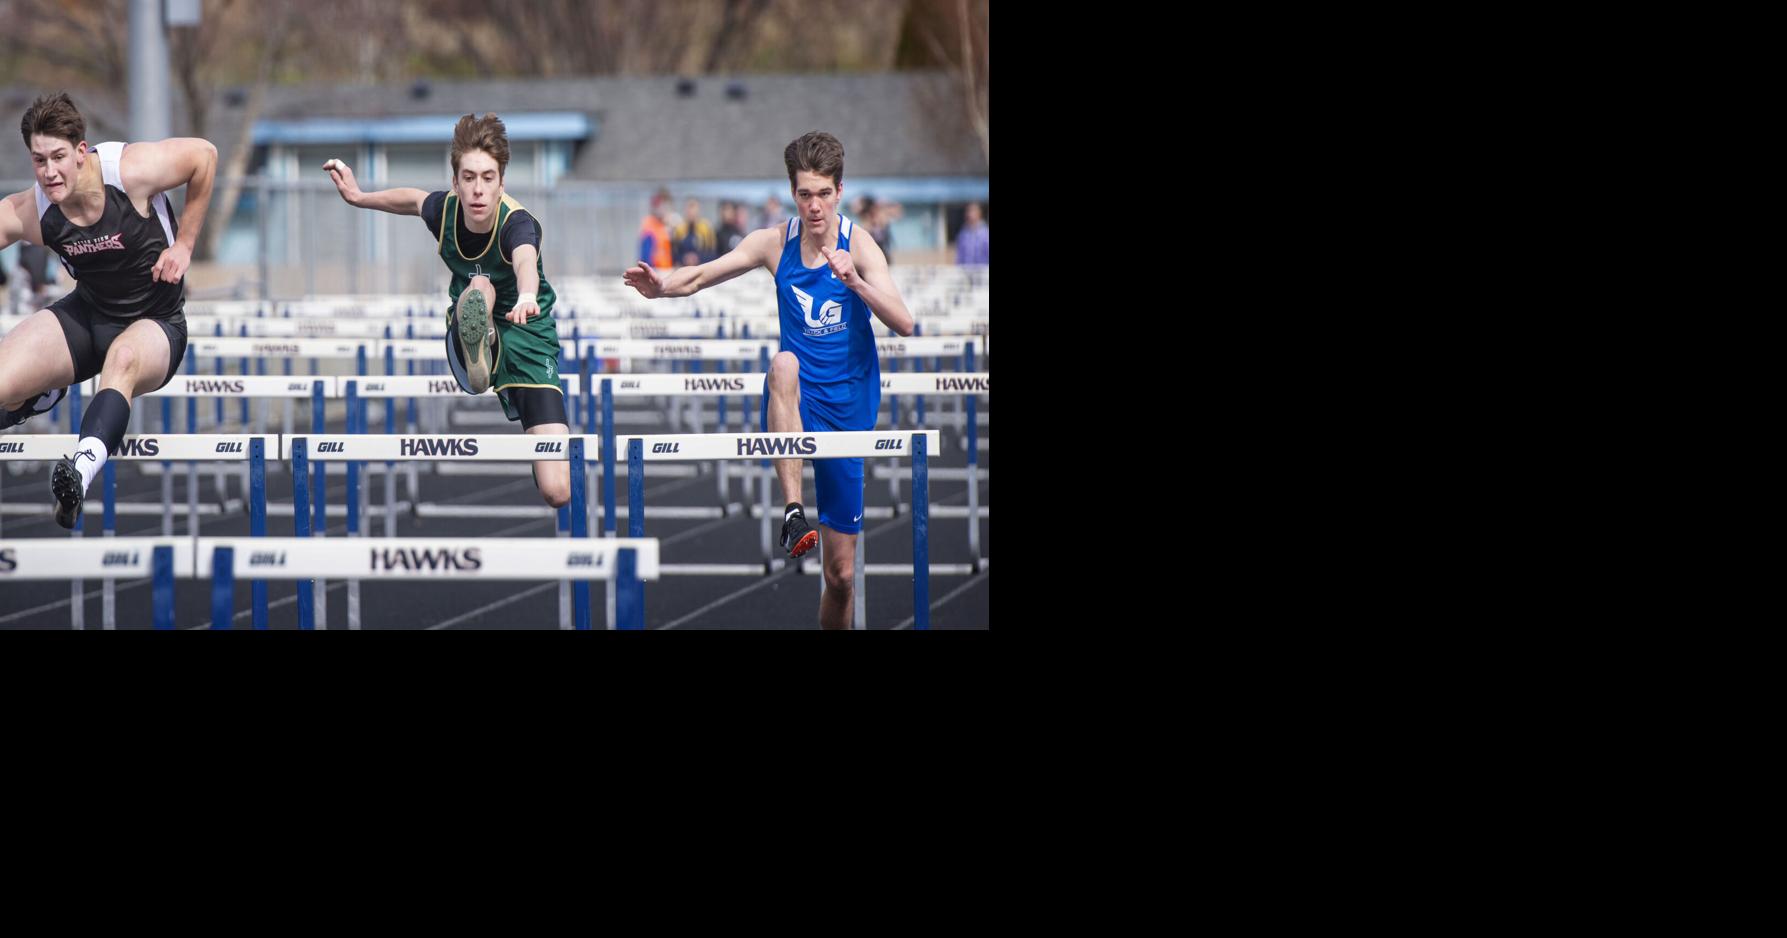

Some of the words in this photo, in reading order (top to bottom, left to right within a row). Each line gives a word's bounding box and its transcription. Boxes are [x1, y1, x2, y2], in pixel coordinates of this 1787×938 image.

[62, 232, 125, 256] PANTHERS
[186, 380, 244, 393] HAWKS
[429, 380, 464, 393] HAW
[685, 378, 744, 391] HAWKS
[0, 442, 24, 453] GILL
[110, 438, 160, 456] WKS
[215, 442, 243, 453] GILL
[317, 442, 344, 453] GILL
[400, 438, 479, 456] HAWKS
[534, 441, 562, 453] GILL
[652, 442, 680, 453] GILL
[737, 436, 817, 456] HAWKS
[875, 438, 902, 450] GILL
[102, 550, 139, 566] GILL
[249, 552, 286, 567] GILL
[370, 547, 482, 571] HAWKS
[566, 552, 604, 567] GILL
